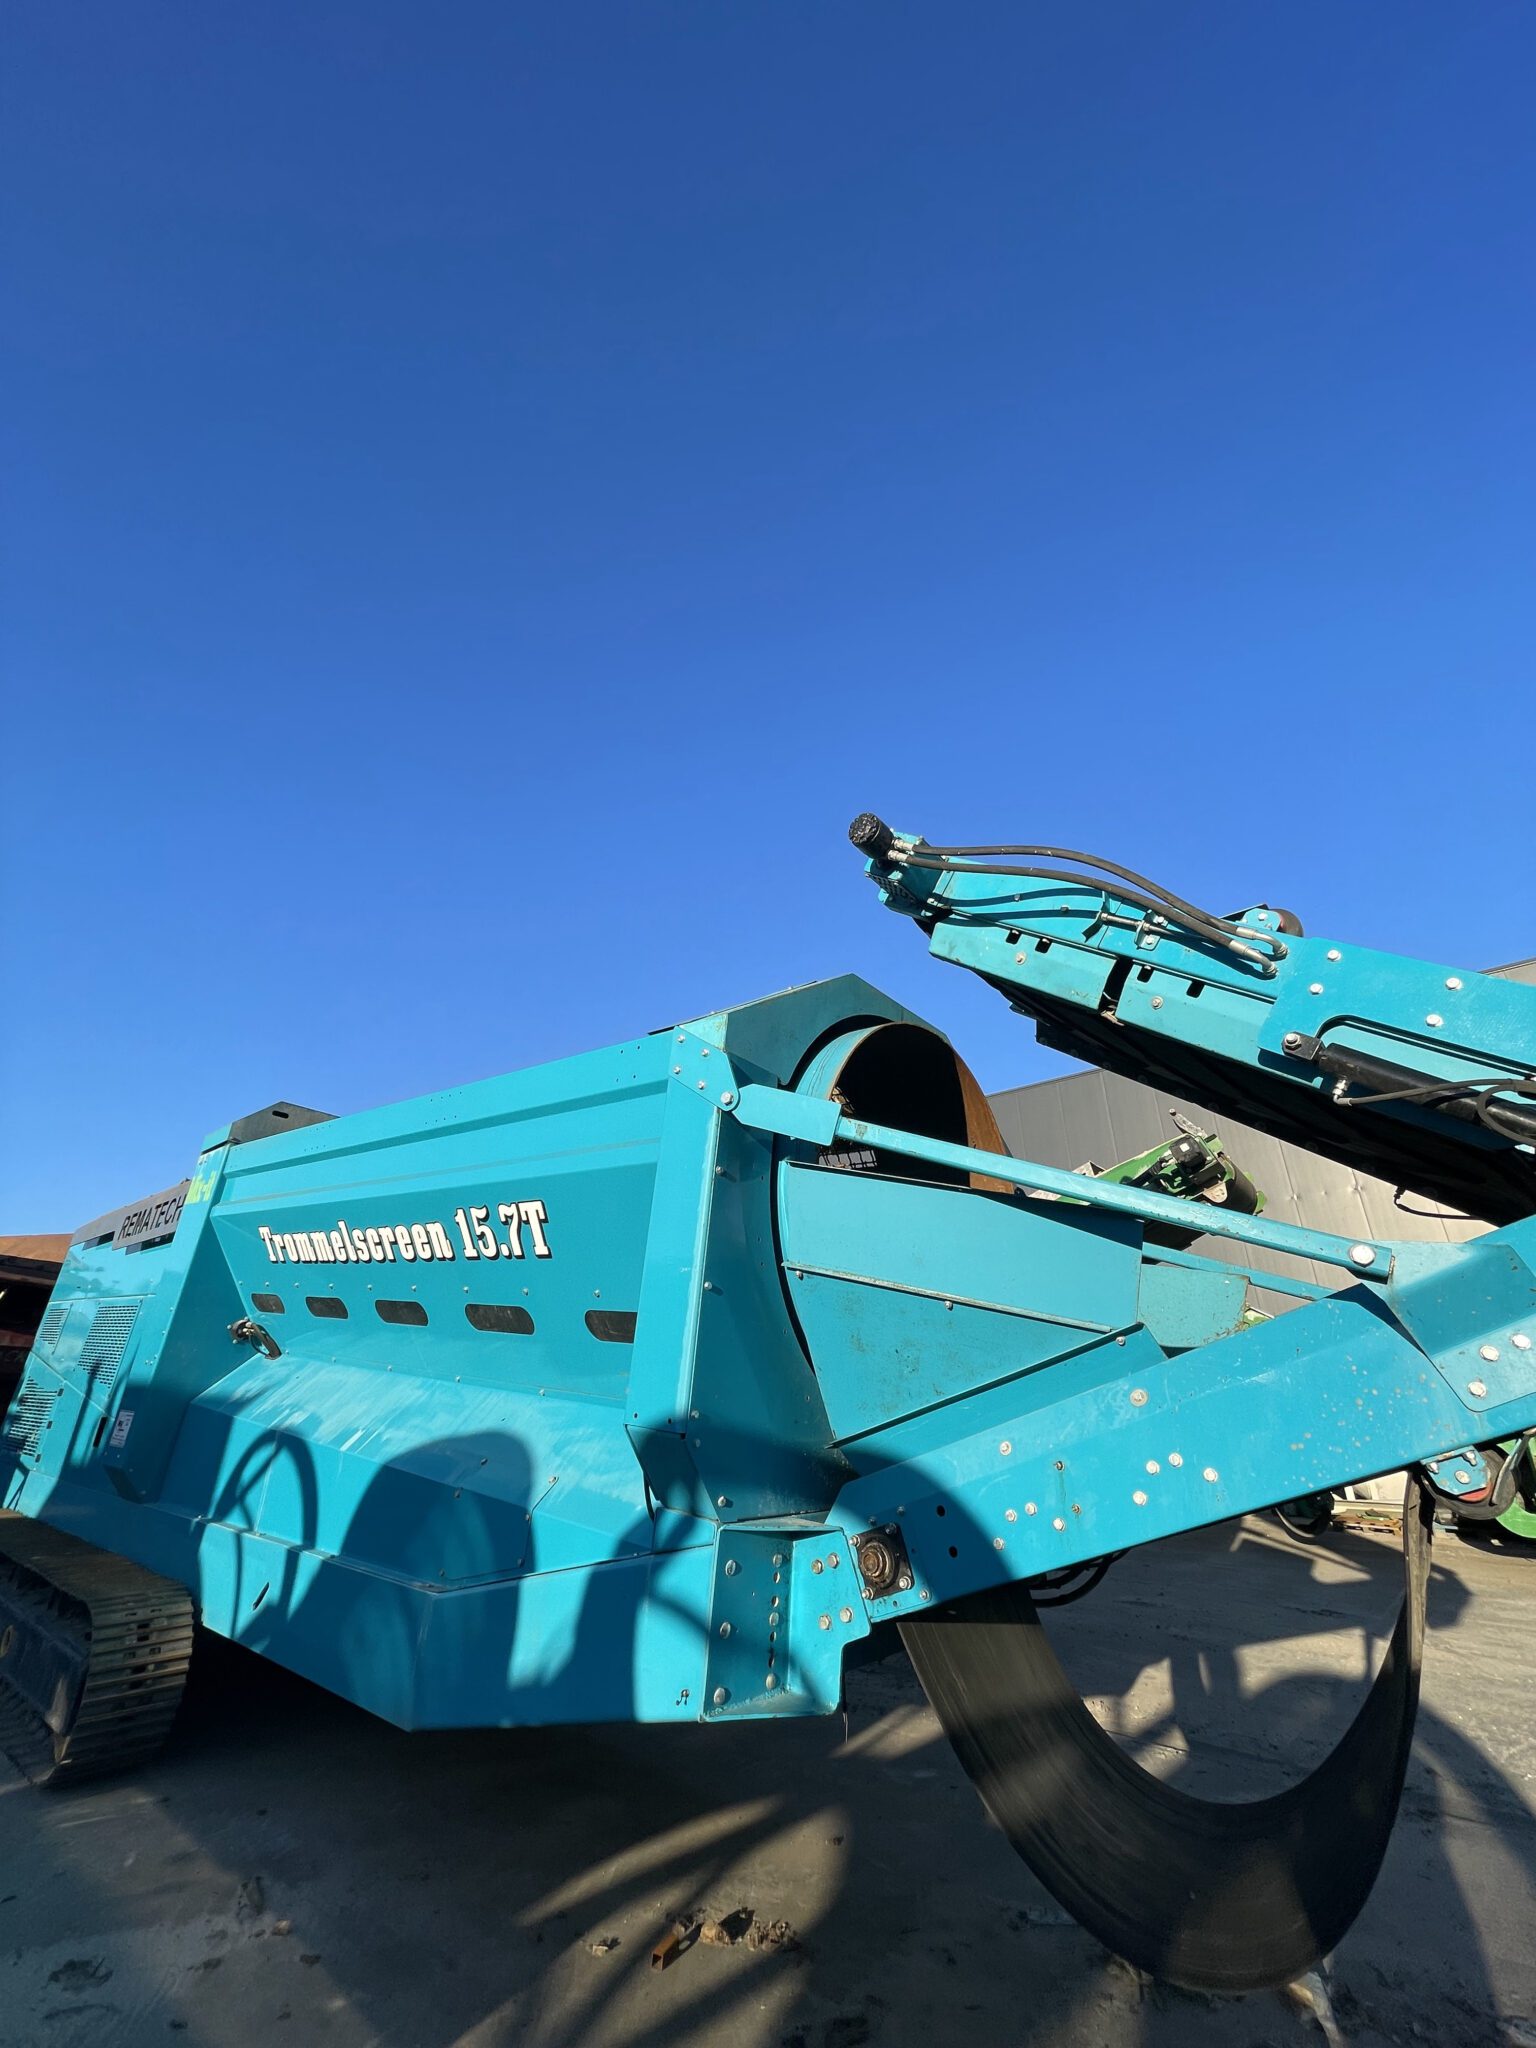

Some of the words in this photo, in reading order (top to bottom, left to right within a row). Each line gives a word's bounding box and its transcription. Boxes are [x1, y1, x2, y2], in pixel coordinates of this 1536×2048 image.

[118, 1194, 187, 1240] REMATECH
[258, 1220, 455, 1264] Trommelscreen
[455, 1200, 552, 1260] 15.7T
